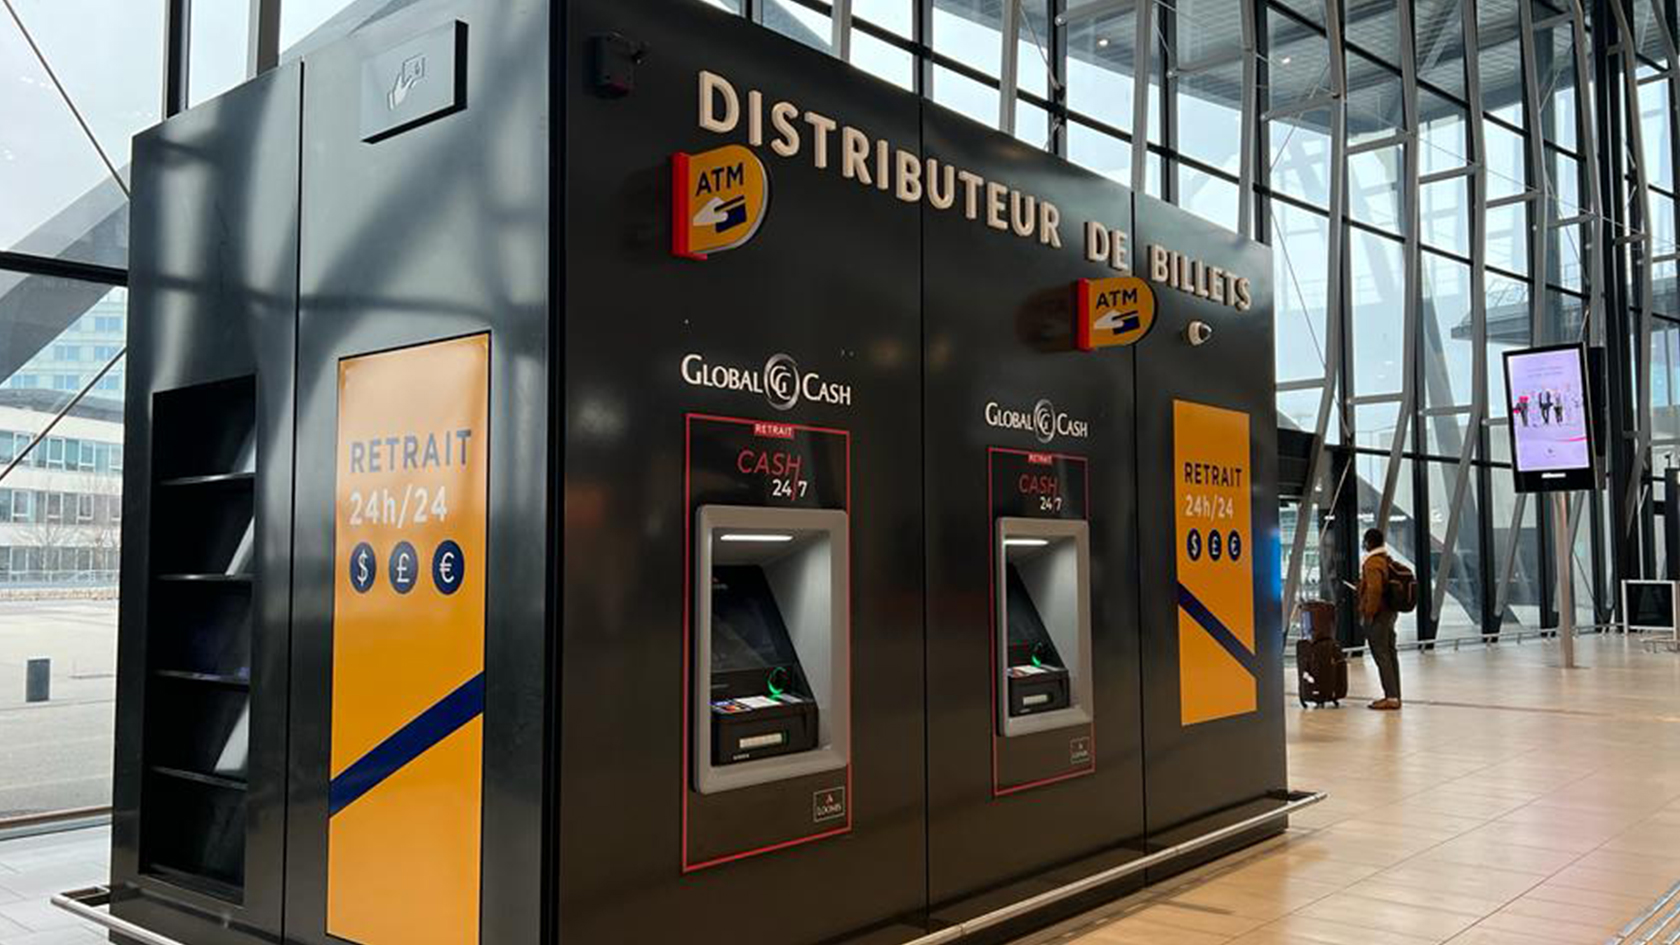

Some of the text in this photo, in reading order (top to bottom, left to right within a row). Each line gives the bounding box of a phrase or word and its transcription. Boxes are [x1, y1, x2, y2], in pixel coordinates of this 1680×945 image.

[696, 162, 745, 196] ATM
[699, 70, 1253, 312] DISTRIBUTEUR DE BILLETS
[1095, 288, 1138, 310] ATM
[681, 354, 763, 393] GLOBAL
[802, 373, 851, 405] CASH
[754, 423, 793, 437] RETRAIT
[985, 402, 1033, 430] GLOBAL
[1057, 413, 1088, 437] CASH
[350, 429, 472, 473] RETRAIT
[737, 449, 802, 476] CASH
[1019, 474, 1058, 494] CASH
[1184, 462, 1242, 487] RETRAIT
[350, 484, 448, 528] 24h/24
[1185, 493, 1234, 522] 24h/24
